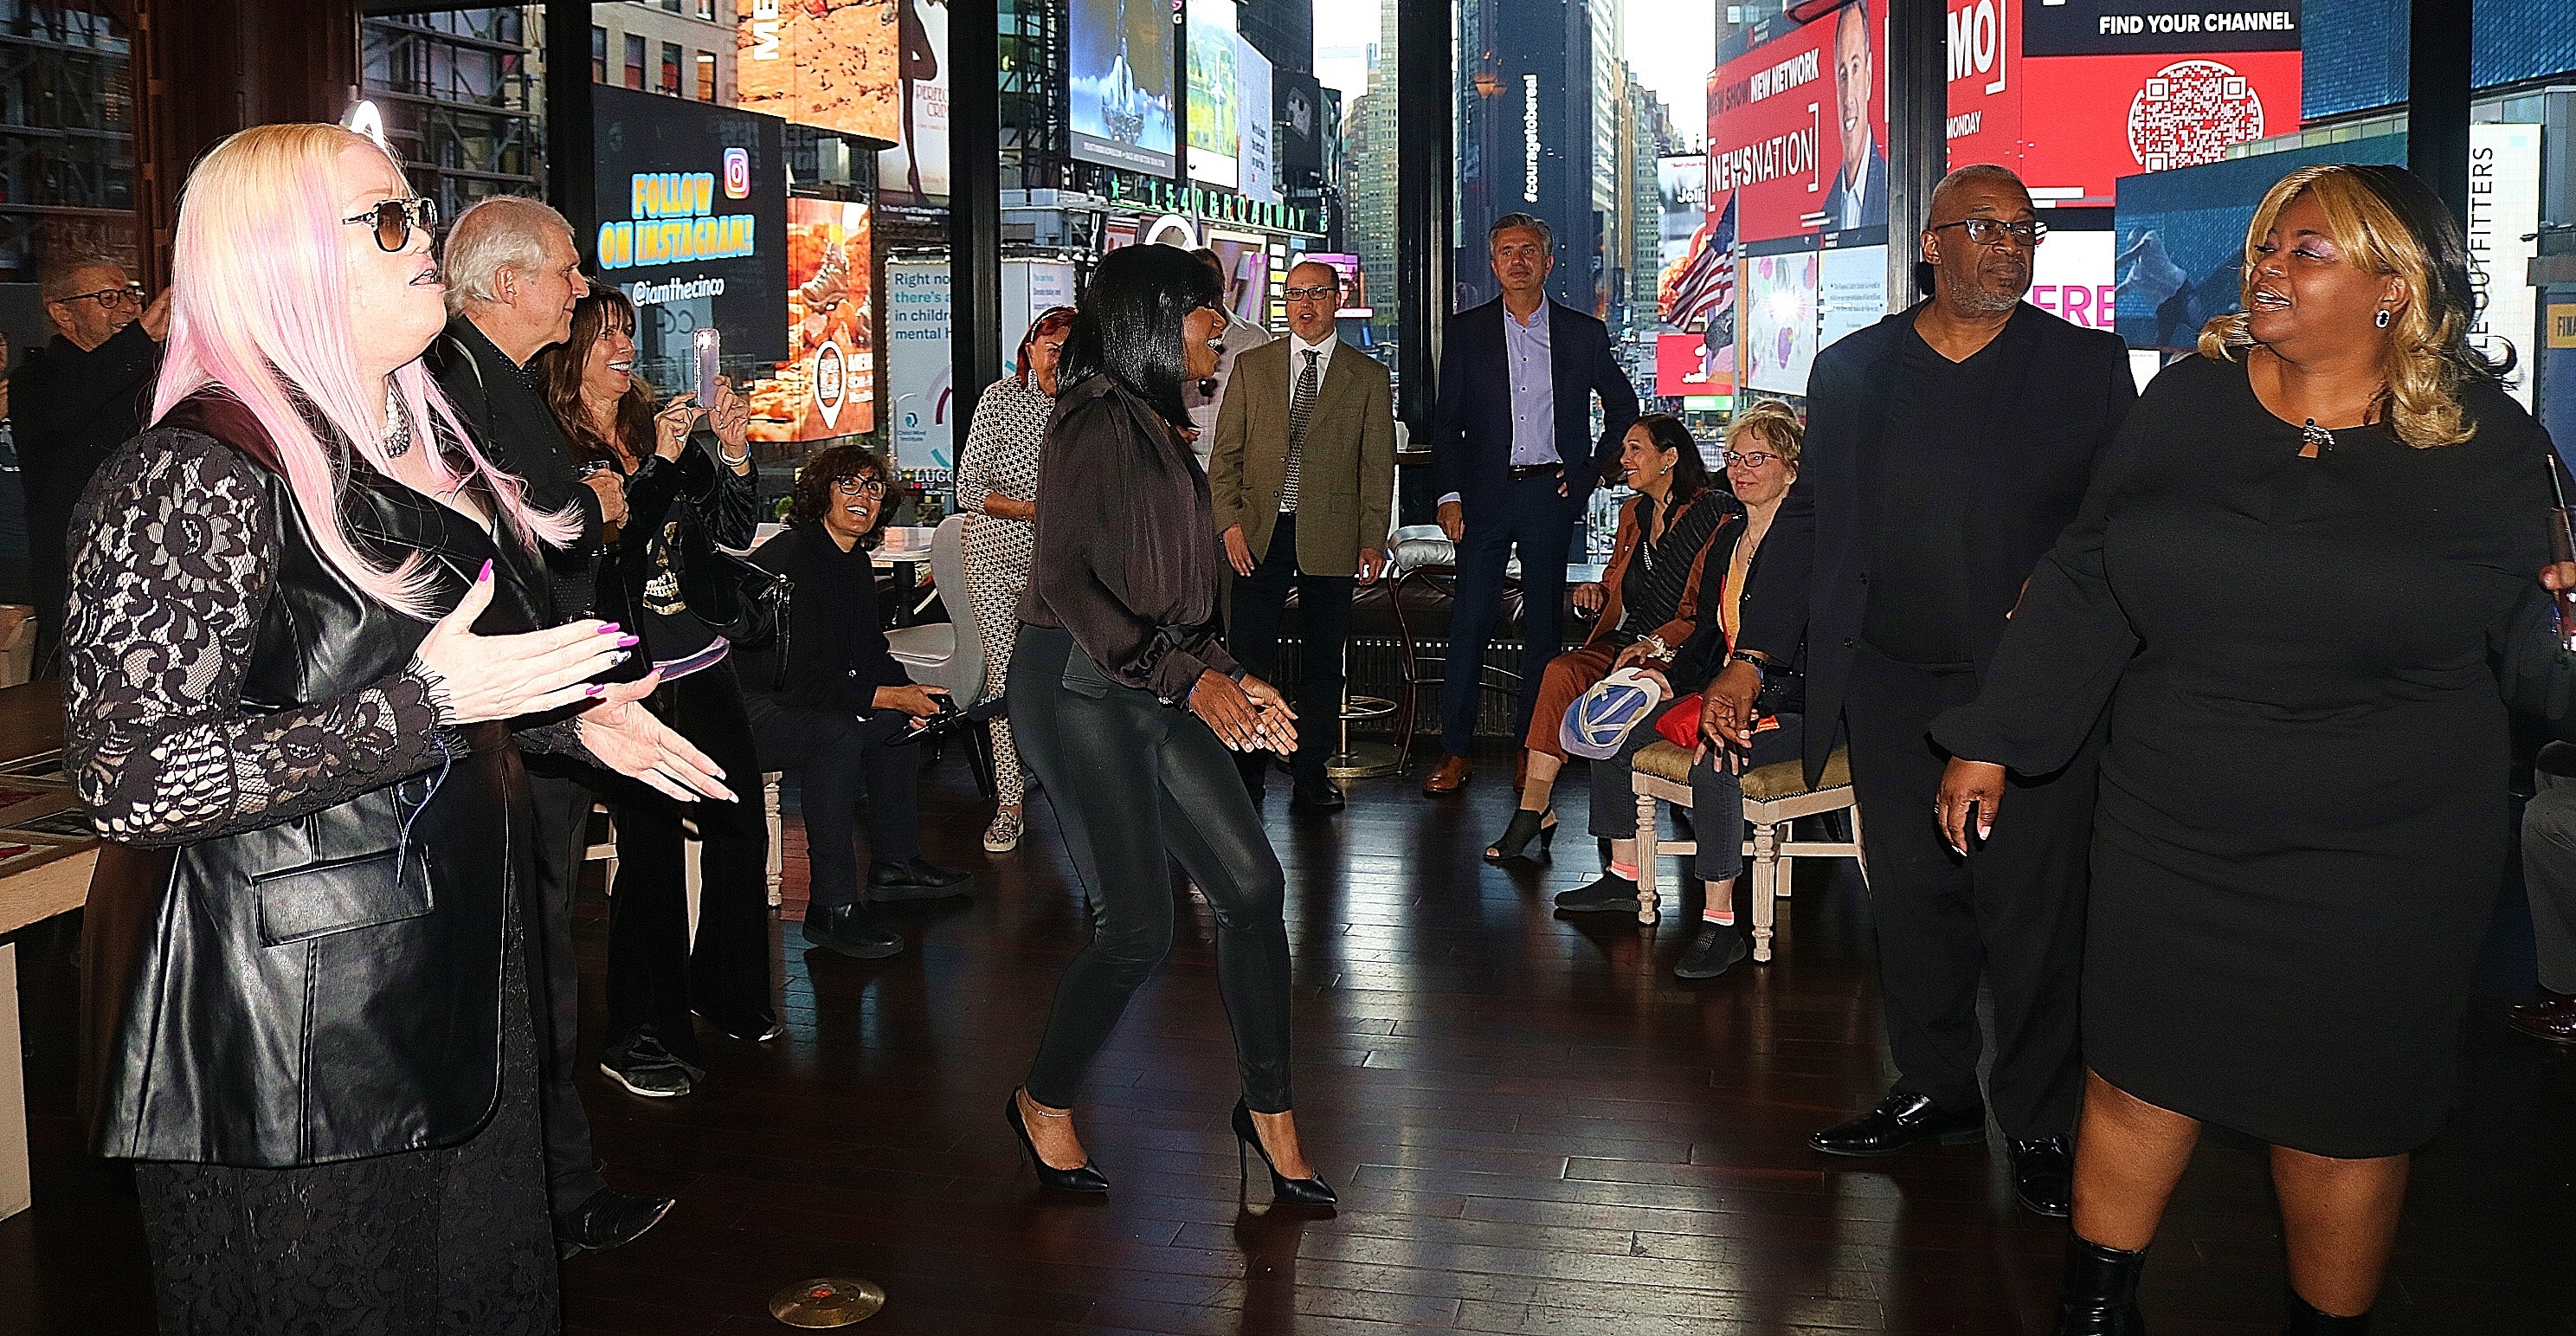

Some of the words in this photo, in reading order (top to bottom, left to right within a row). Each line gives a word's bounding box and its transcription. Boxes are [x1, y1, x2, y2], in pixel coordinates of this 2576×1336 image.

[2099, 16, 2144, 35] FIND
[2148, 14, 2200, 33] YOUR
[2204, 11, 2295, 32] CHANNEL
[1750, 68, 1772, 104] NEW
[1771, 48, 1819, 96] NETWORK
[1523, 74, 1542, 203] #couragetobereal
[1946, 110, 1982, 139] MONDAY
[632, 172, 715, 220] FOLLOW
[1149, 180, 1204, 213] 1540
[1208, 190, 1306, 231] BROADWAY
[597, 221, 634, 270] ON
[634, 214, 755, 267] INSTAGRAM!
[2470, 147, 2493, 309] OUTFITTERS
[632, 274, 724, 307] @iamthecinco
[895, 272, 930, 287] Right
[895, 291, 941, 303] there's
[895, 309, 907, 321] in
[895, 326, 941, 339] mental
